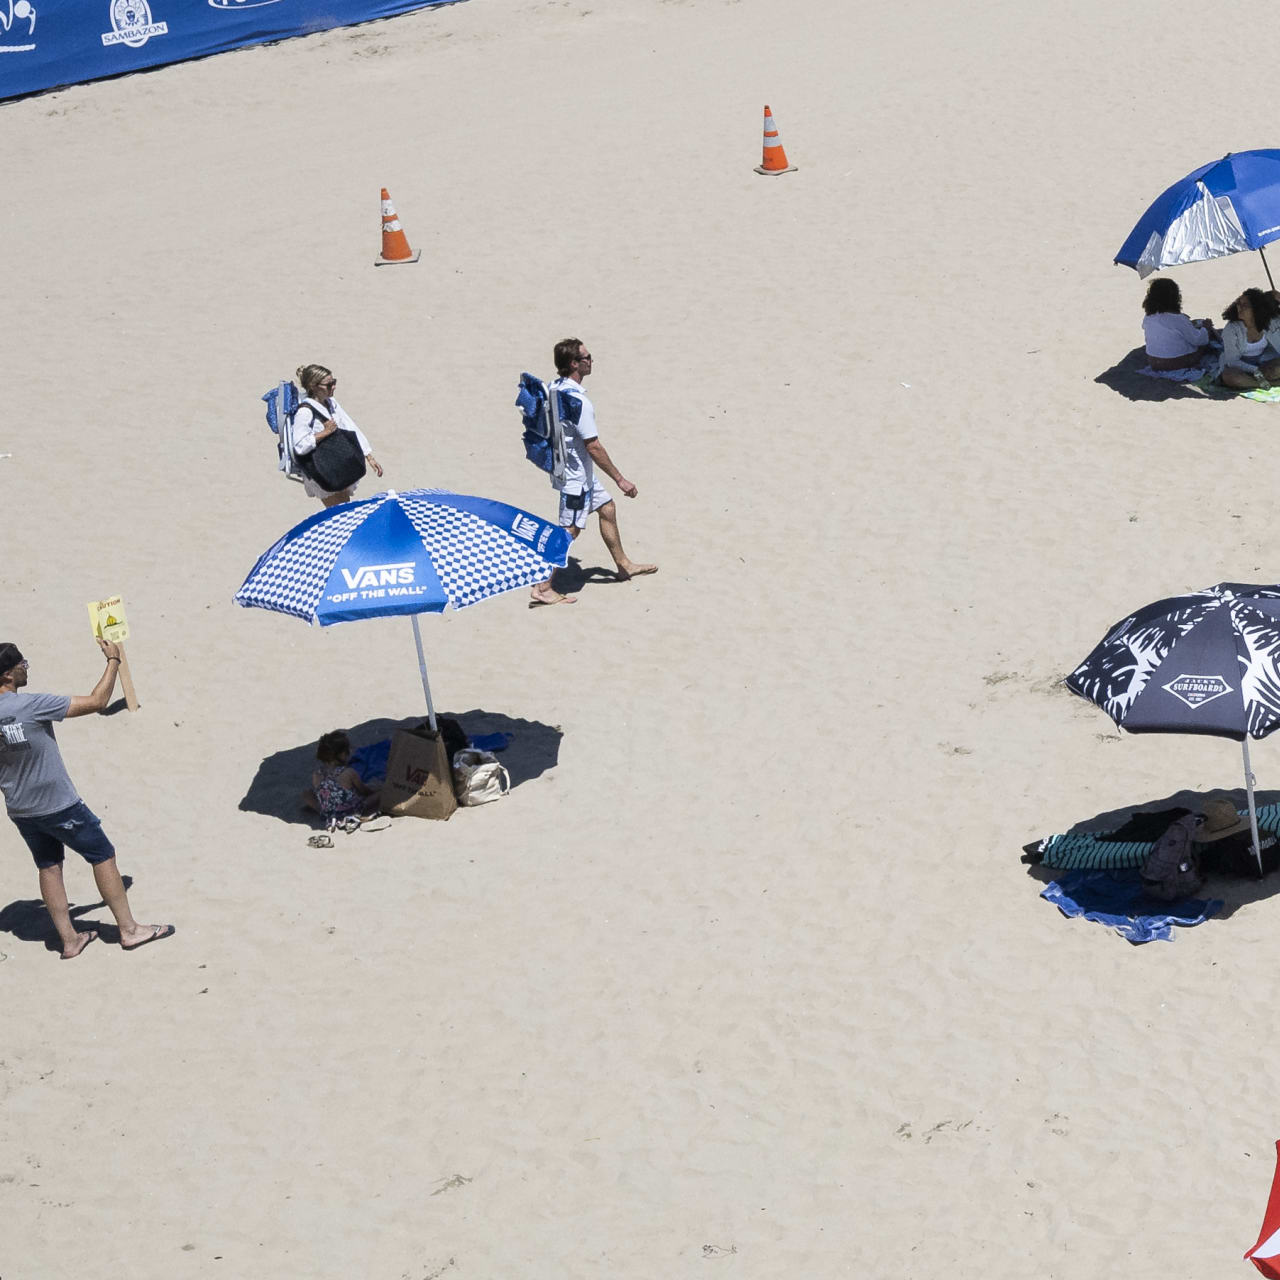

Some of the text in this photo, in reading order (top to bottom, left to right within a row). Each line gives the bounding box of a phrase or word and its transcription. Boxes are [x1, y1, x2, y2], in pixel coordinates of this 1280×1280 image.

[103, 24, 166, 44] SAMBAZON
[511, 513, 540, 542] VANS
[341, 563, 416, 588] VANS
[326, 585, 427, 603] "OFF THE WALL"
[1173, 683, 1224, 691] SURFBOARDS
